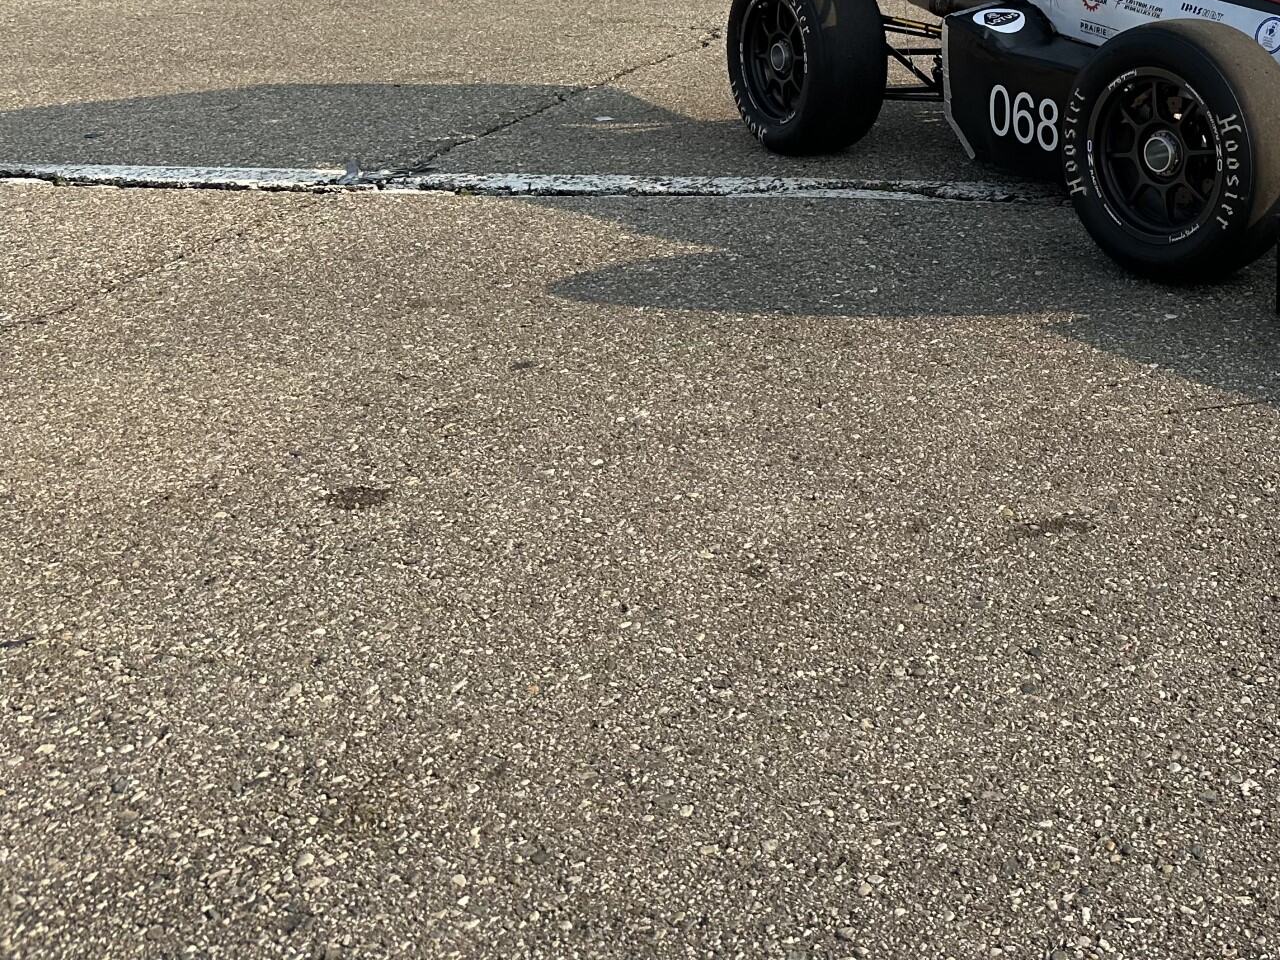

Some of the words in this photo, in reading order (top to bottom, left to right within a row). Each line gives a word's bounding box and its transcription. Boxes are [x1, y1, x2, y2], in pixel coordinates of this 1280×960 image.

[1080, 22, 1107, 36] PRAIRIE
[989, 84, 1059, 152] 068
[1215, 112, 1245, 230] Hoosier
